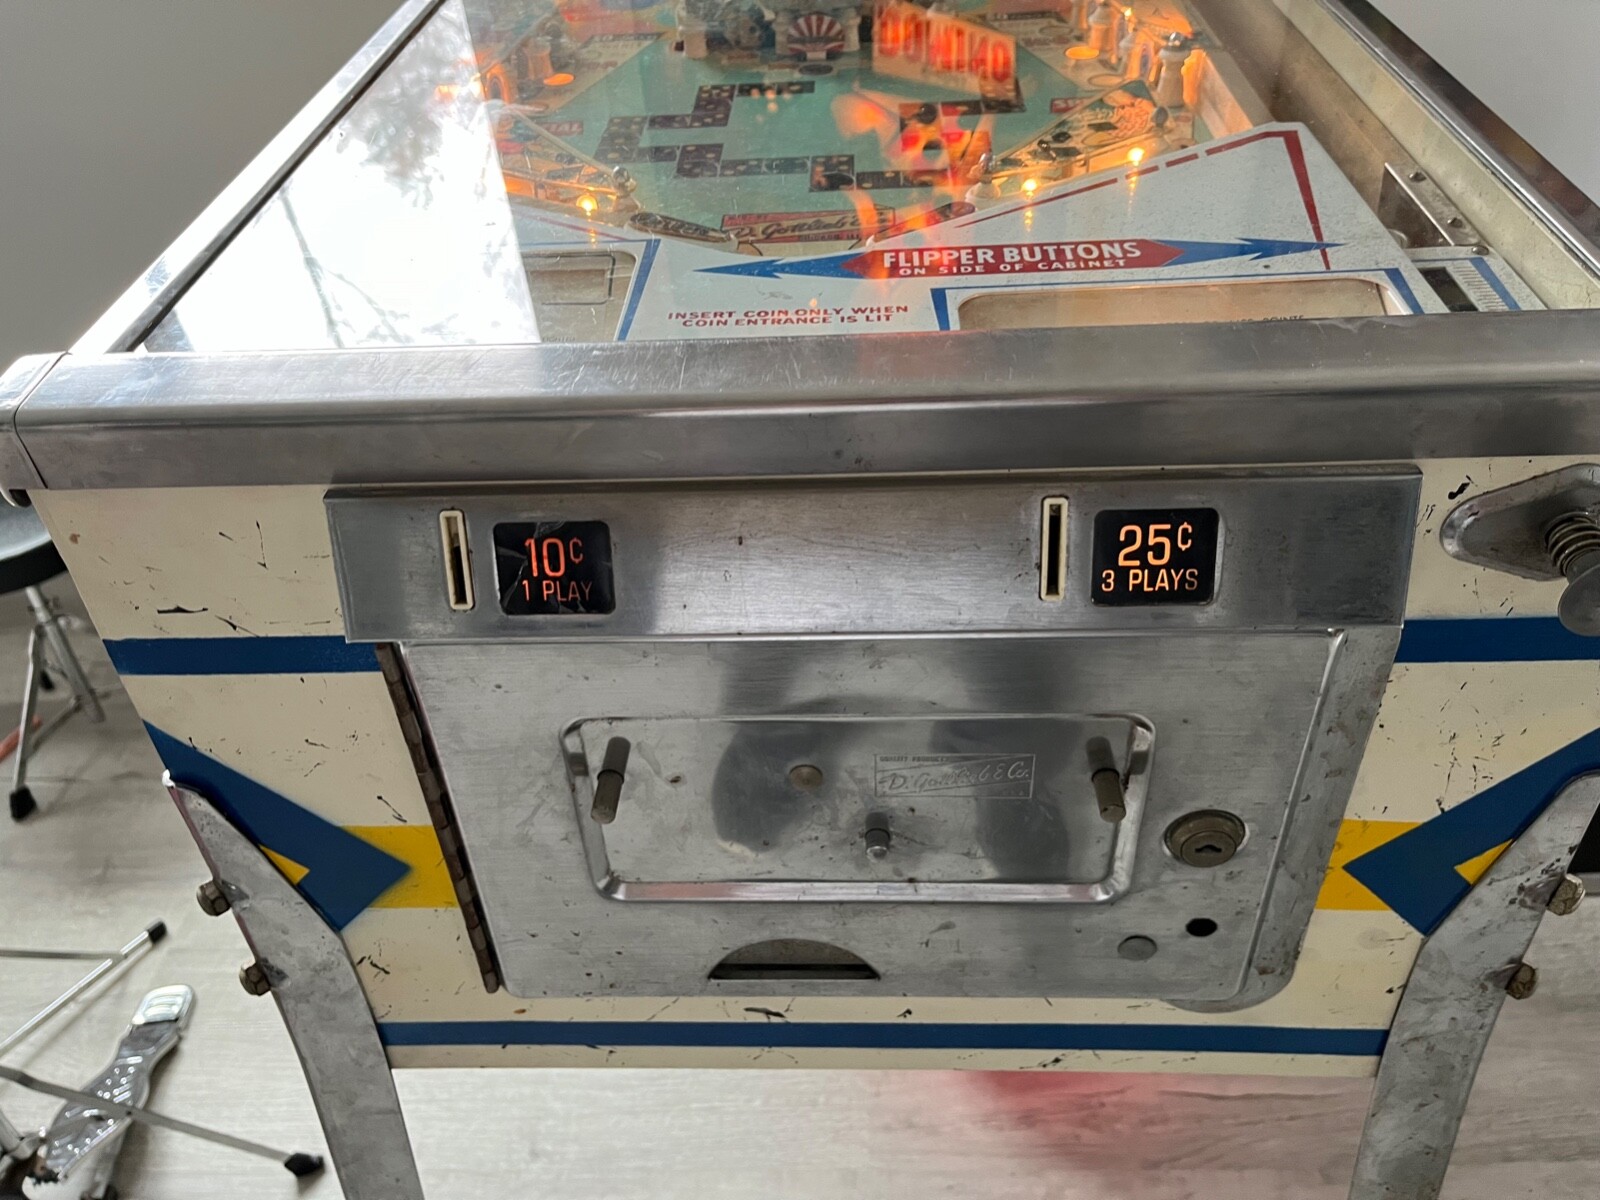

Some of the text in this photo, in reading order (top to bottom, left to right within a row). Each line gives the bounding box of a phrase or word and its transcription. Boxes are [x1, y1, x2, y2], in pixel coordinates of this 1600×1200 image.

[883, 242, 1142, 268] FLIPPER BUTTONS
[899, 267, 927, 276] ON
[938, 265, 985, 275] SIDE
[1000, 263, 1024, 272] OF
[668, 305, 908, 320] INSERT COIN ONLY WHEN
[682, 314, 893, 327] COIN ENTRANCE IS LIT
[1101, 568, 1199, 593] 3 PLAYS
[522, 579, 593, 602] 1 PLAY
[1007, 761, 1030, 779] Co.
